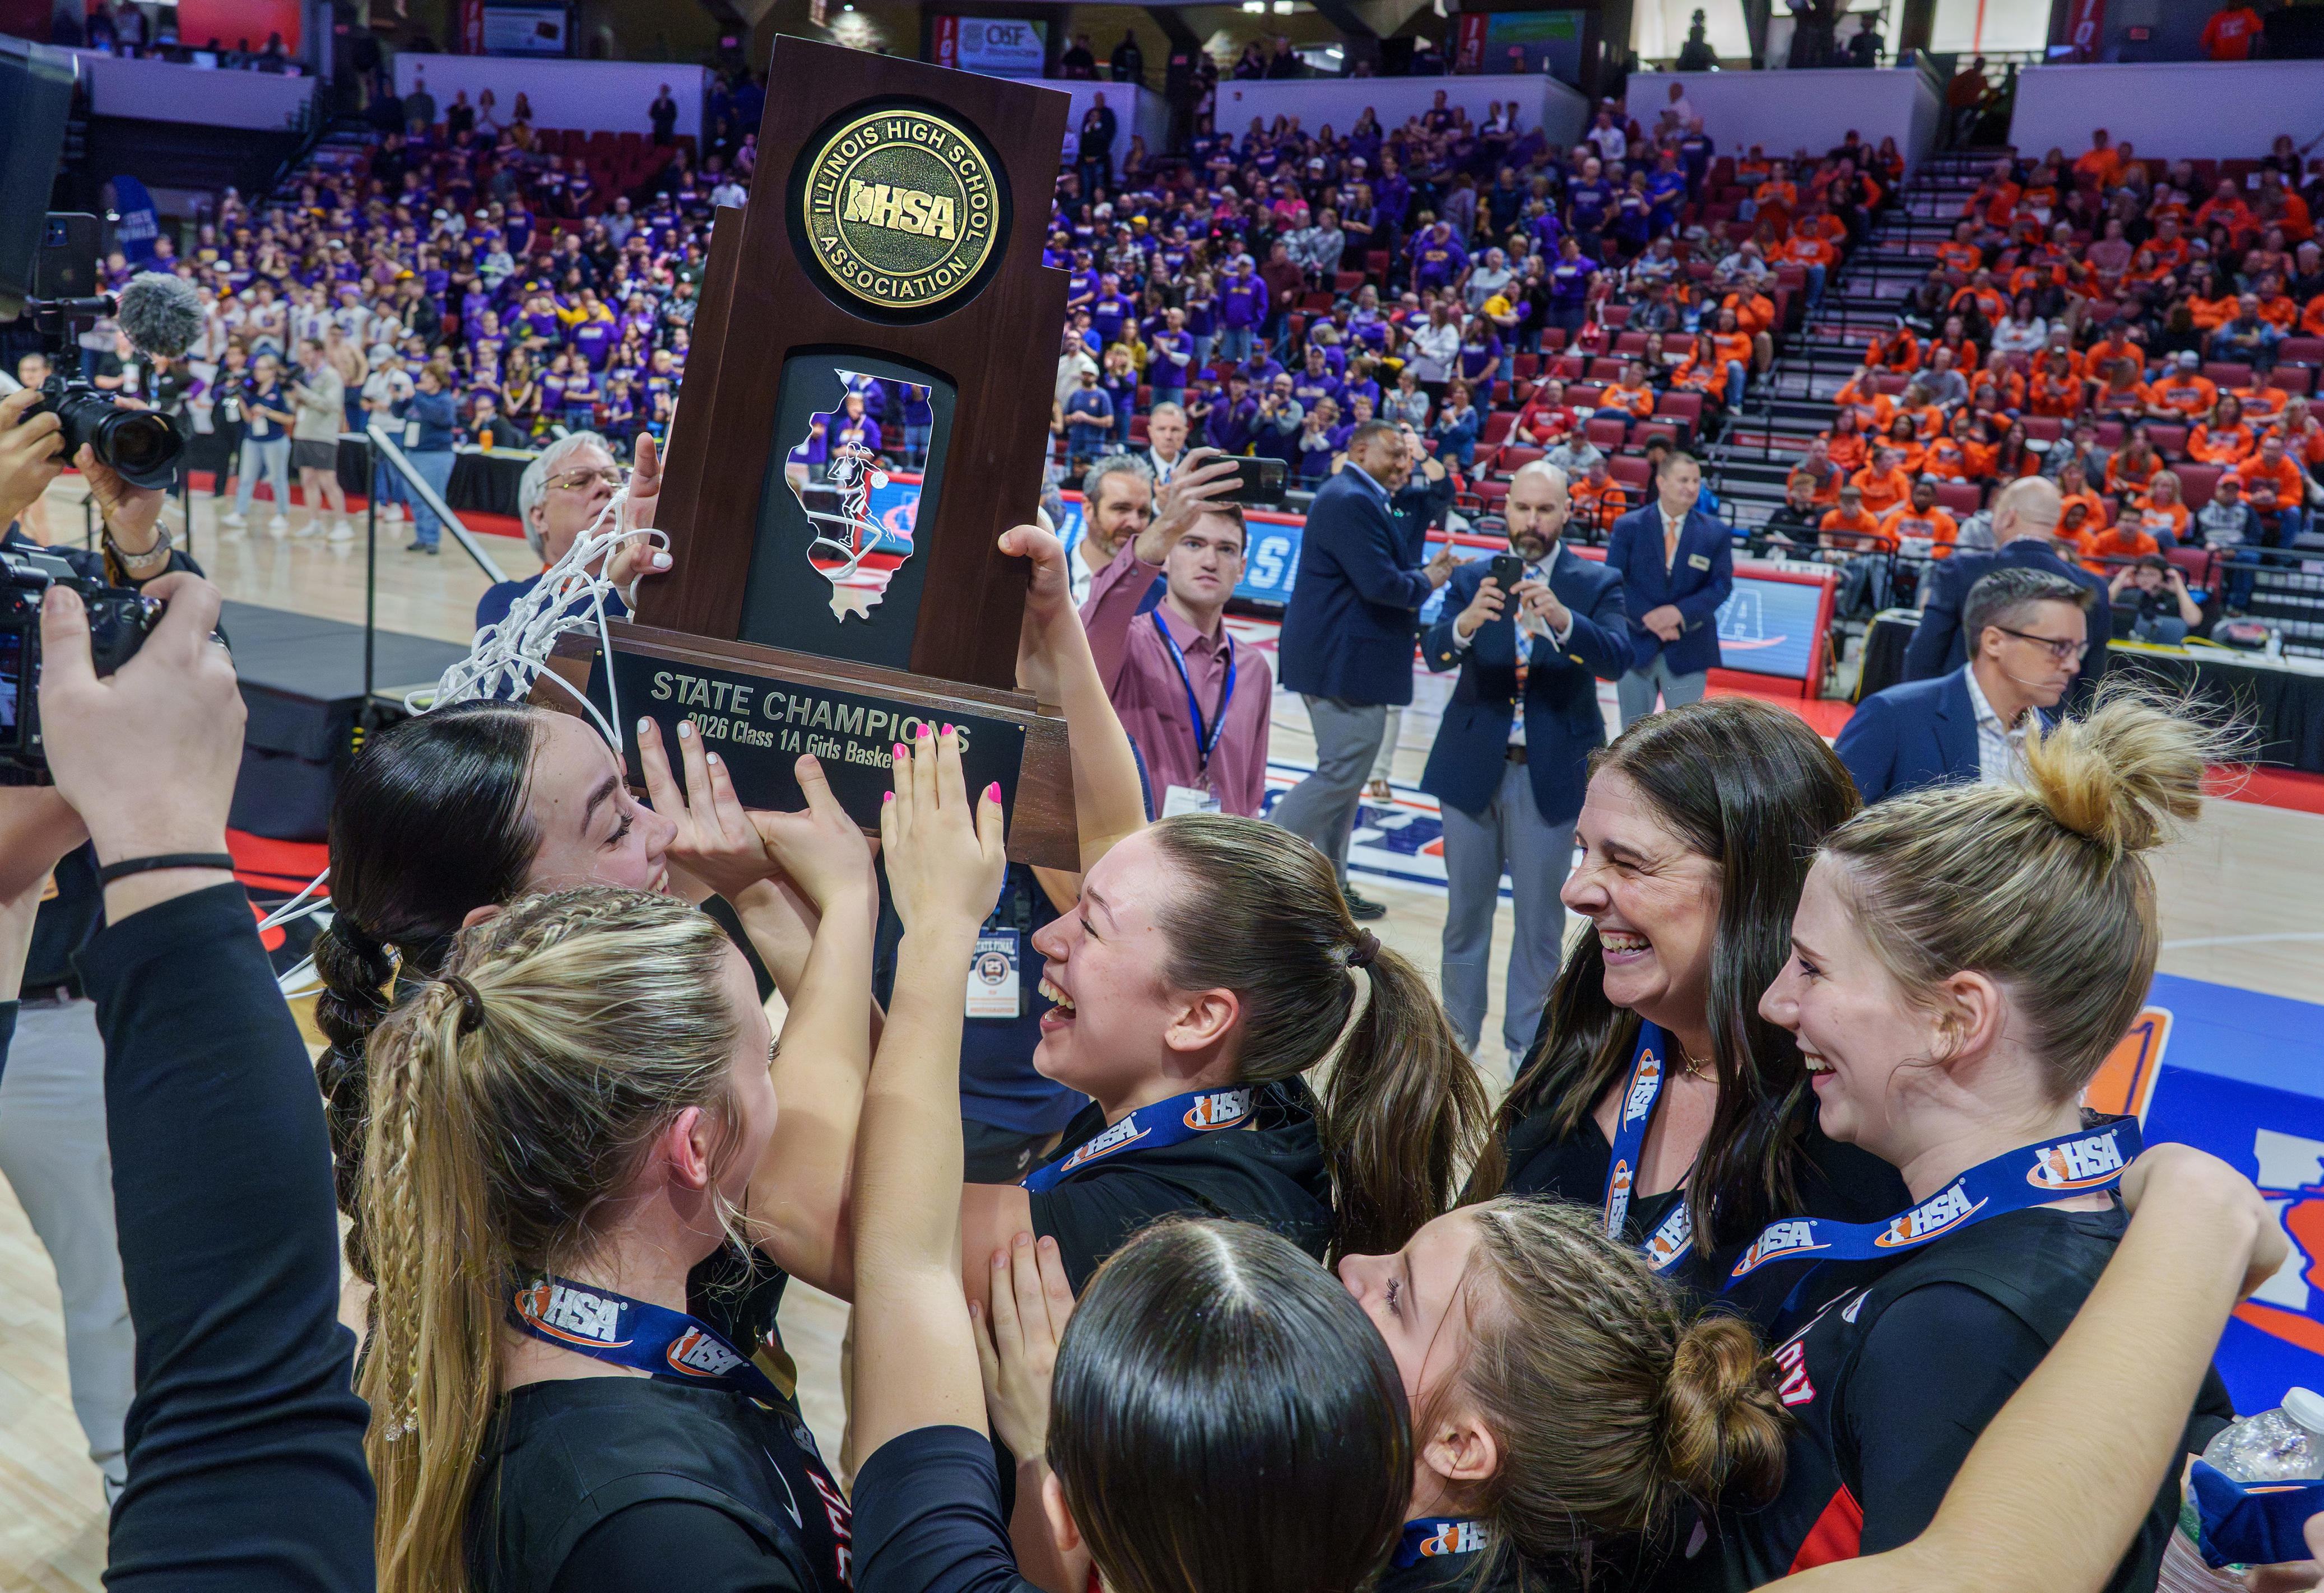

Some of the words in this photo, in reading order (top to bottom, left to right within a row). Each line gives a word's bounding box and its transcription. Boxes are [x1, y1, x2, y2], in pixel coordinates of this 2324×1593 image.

[815, 125, 879, 213] ILLINOIS
[886, 120, 947, 150] HIGH
[948, 144, 988, 242] SCHOOL
[843, 179, 956, 241] IHSA
[820, 235, 968, 299] ASSOCIATION
[650, 671, 754, 716] STATE
[687, 711, 728, 739] 2026
[732, 720, 774, 748] Class
[780, 728, 801, 753] 1A
[806, 733, 842, 760] Girls
[845, 740, 894, 769] Baske
[1194, 1088, 1251, 1126] IHSA
[1626, 1059, 1661, 1121] IHSA
[1070, 1115, 1138, 1167] IHSA
[2035, 1133, 2125, 1186] IHSA
[1890, 1184, 1973, 1244] IHSA
[1742, 1221, 1815, 1271] IHSA
[671, 1325, 743, 1375] IHSA
